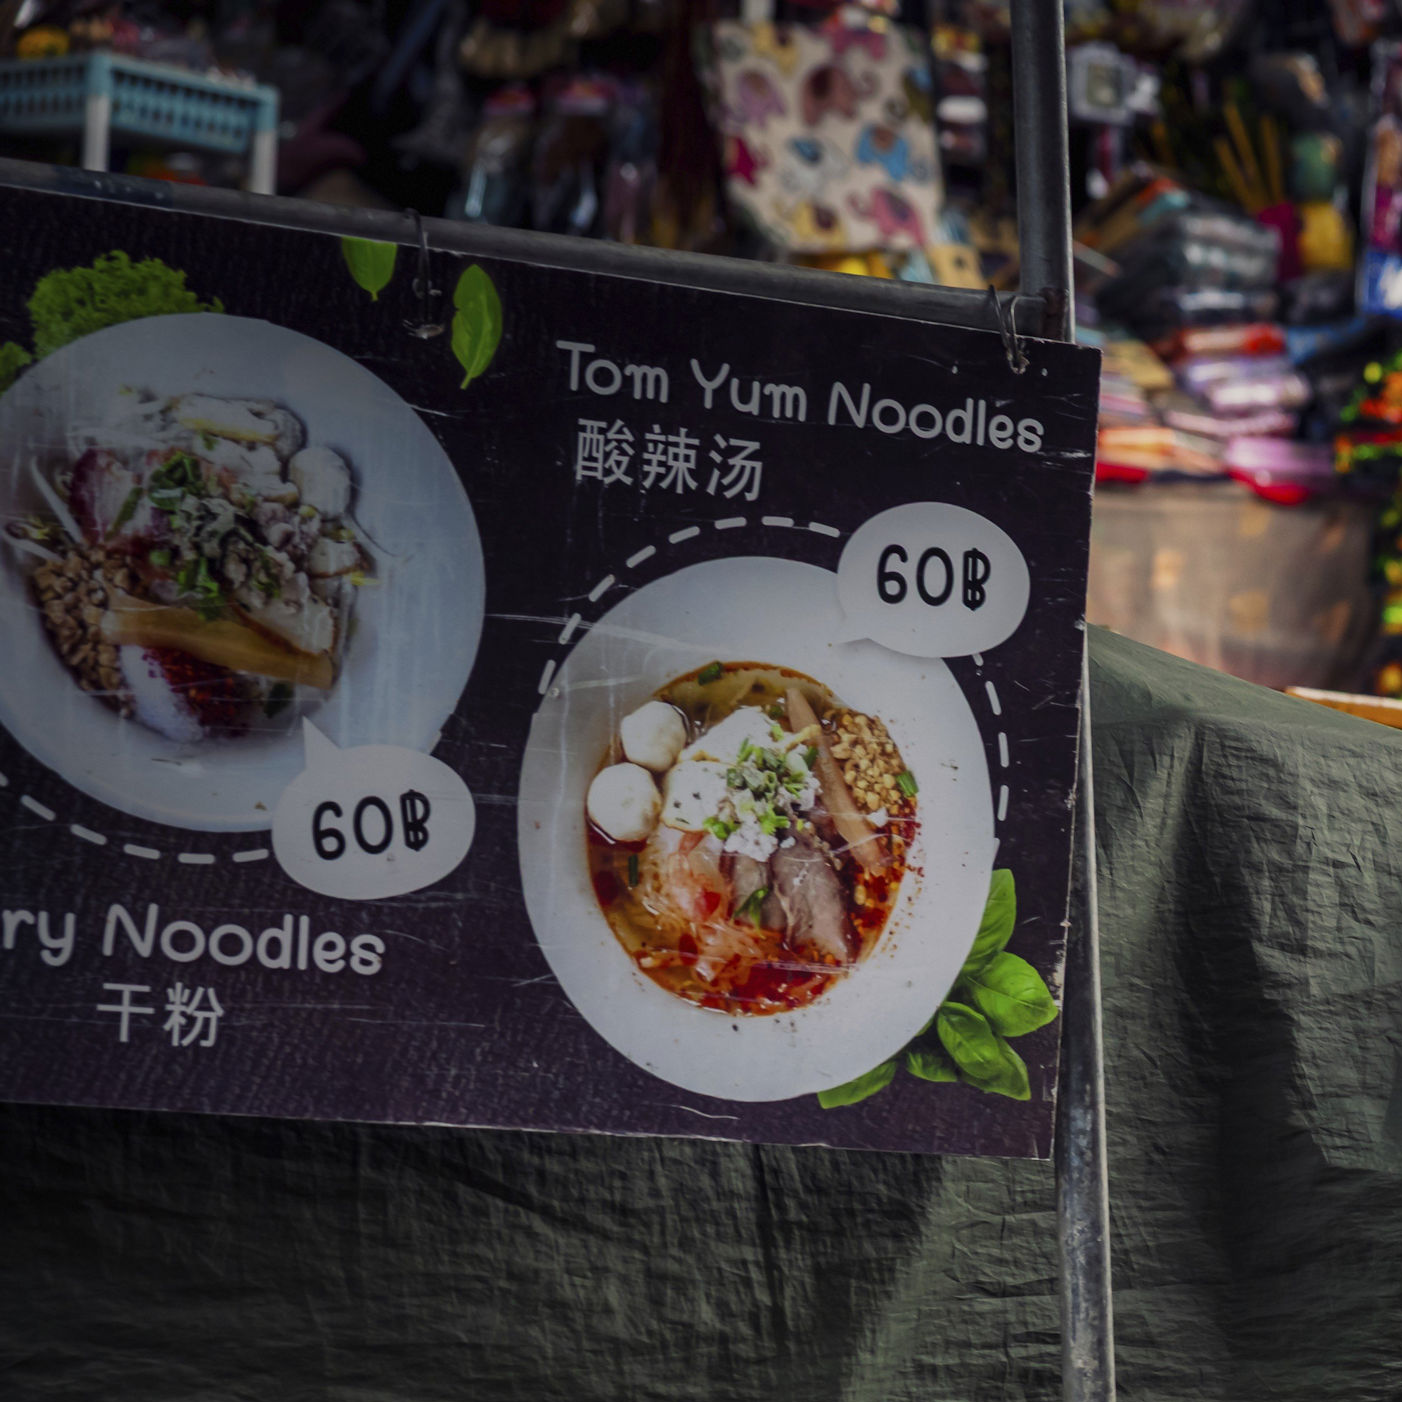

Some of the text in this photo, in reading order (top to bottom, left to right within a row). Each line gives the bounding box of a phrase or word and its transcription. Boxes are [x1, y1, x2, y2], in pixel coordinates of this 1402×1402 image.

[556, 340, 1045, 453] Tom Yum Noodles
[576, 418, 763, 502] 酸辣汤
[102, 903, 386, 976] Noodles
[97, 982, 224, 1048] 干粉
